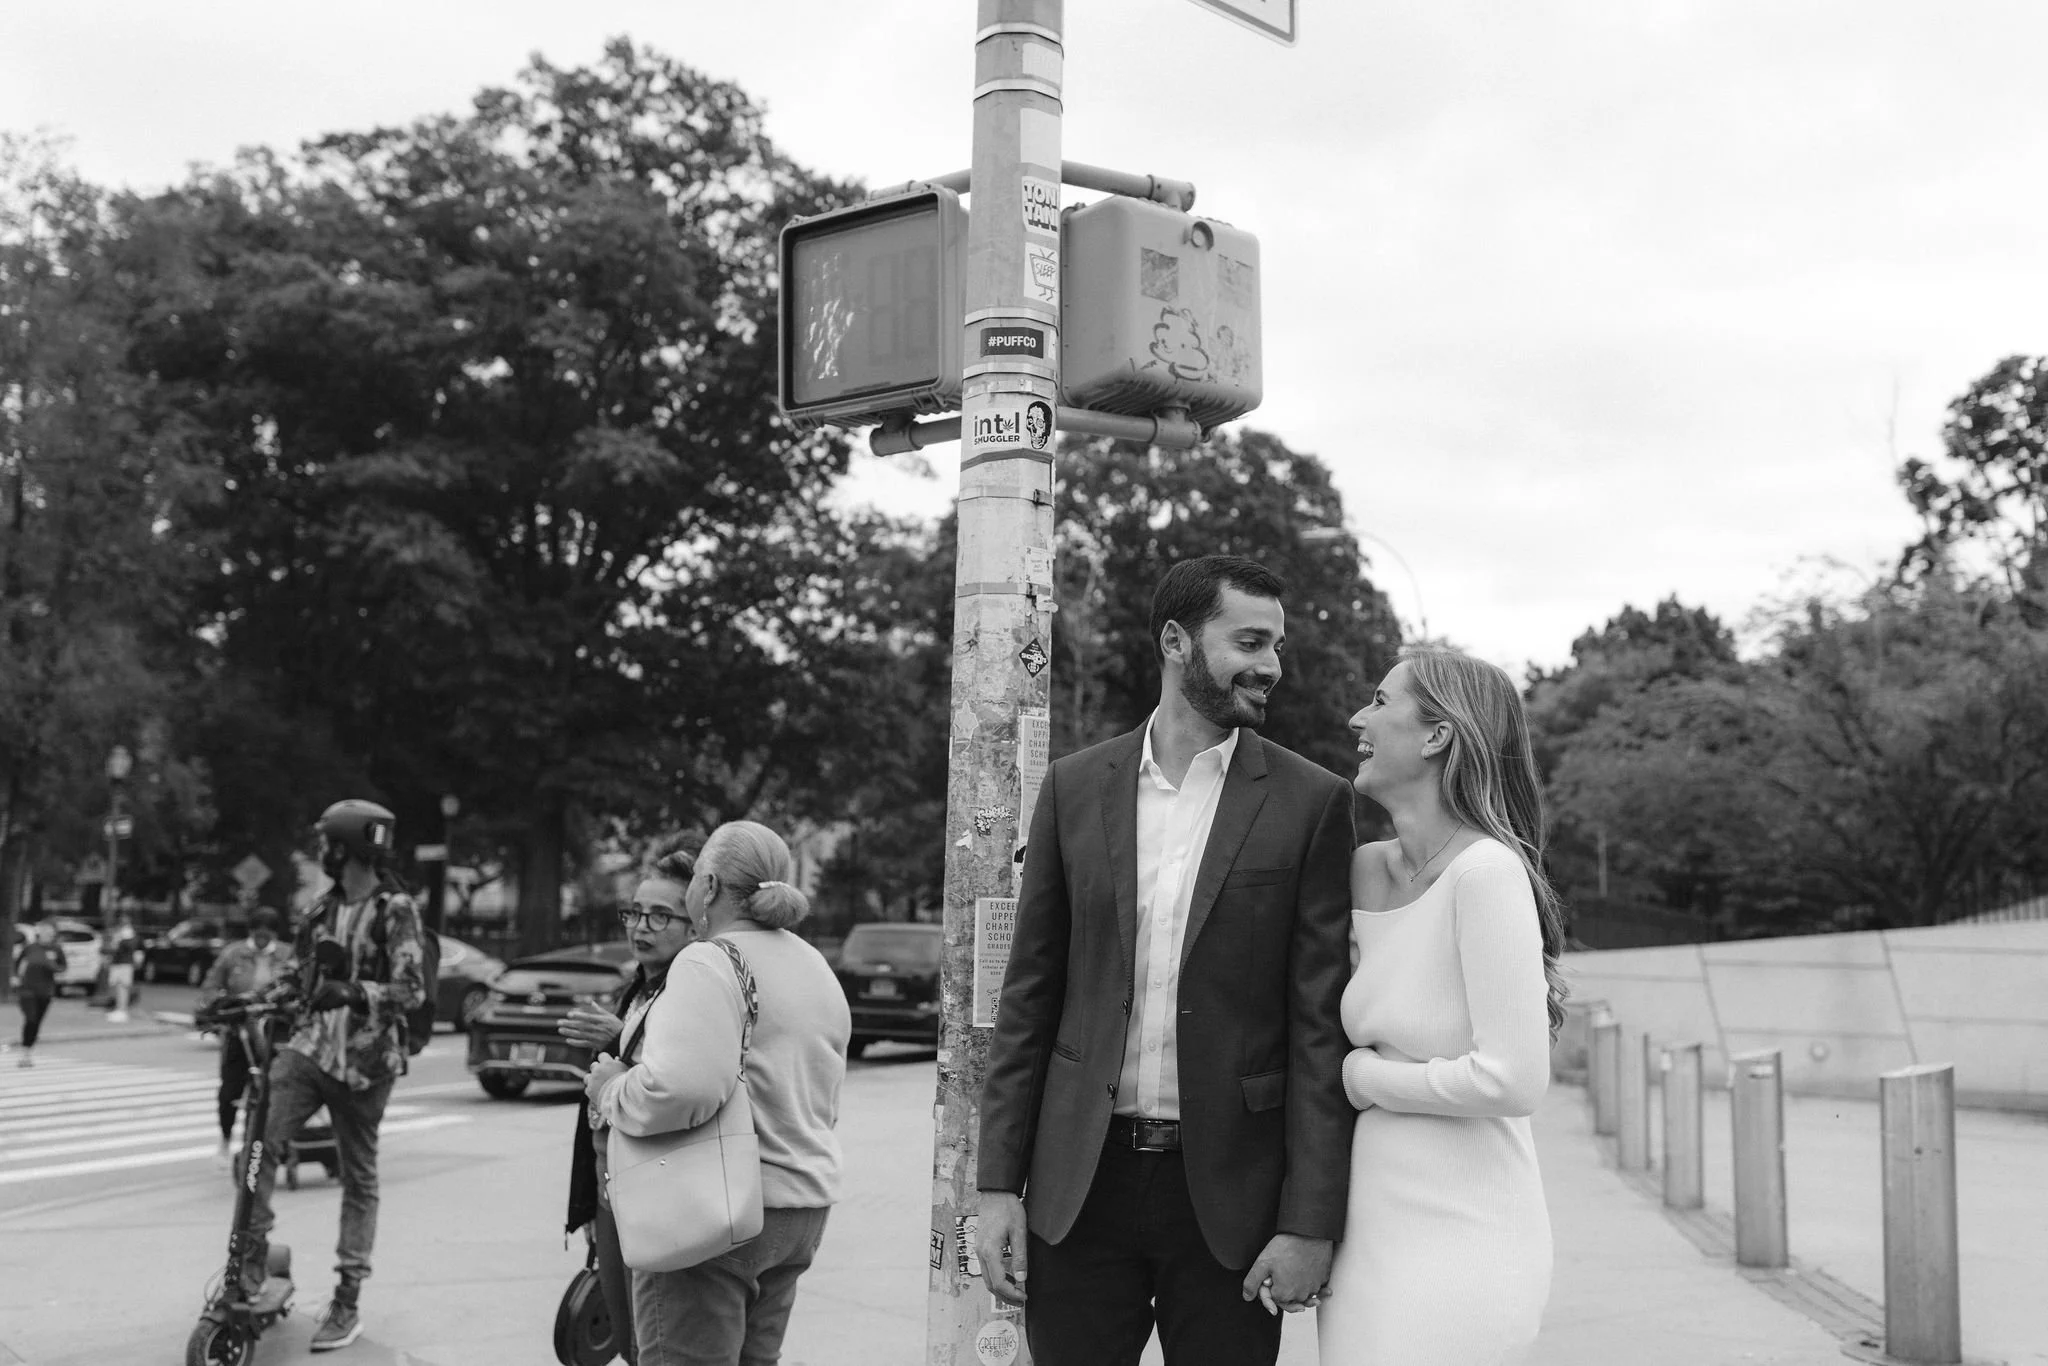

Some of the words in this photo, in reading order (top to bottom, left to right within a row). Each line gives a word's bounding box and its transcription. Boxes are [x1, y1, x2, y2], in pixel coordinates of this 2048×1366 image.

[987, 335, 1036, 348] #PUFFCO
[974, 434, 1020, 445] SMUGGLER
[990, 901, 1017, 911] EXCEE
[985, 922, 1014, 931] CHART
[987, 932, 1012, 942] SCHO
[246, 1140, 264, 1193] APOLLO
